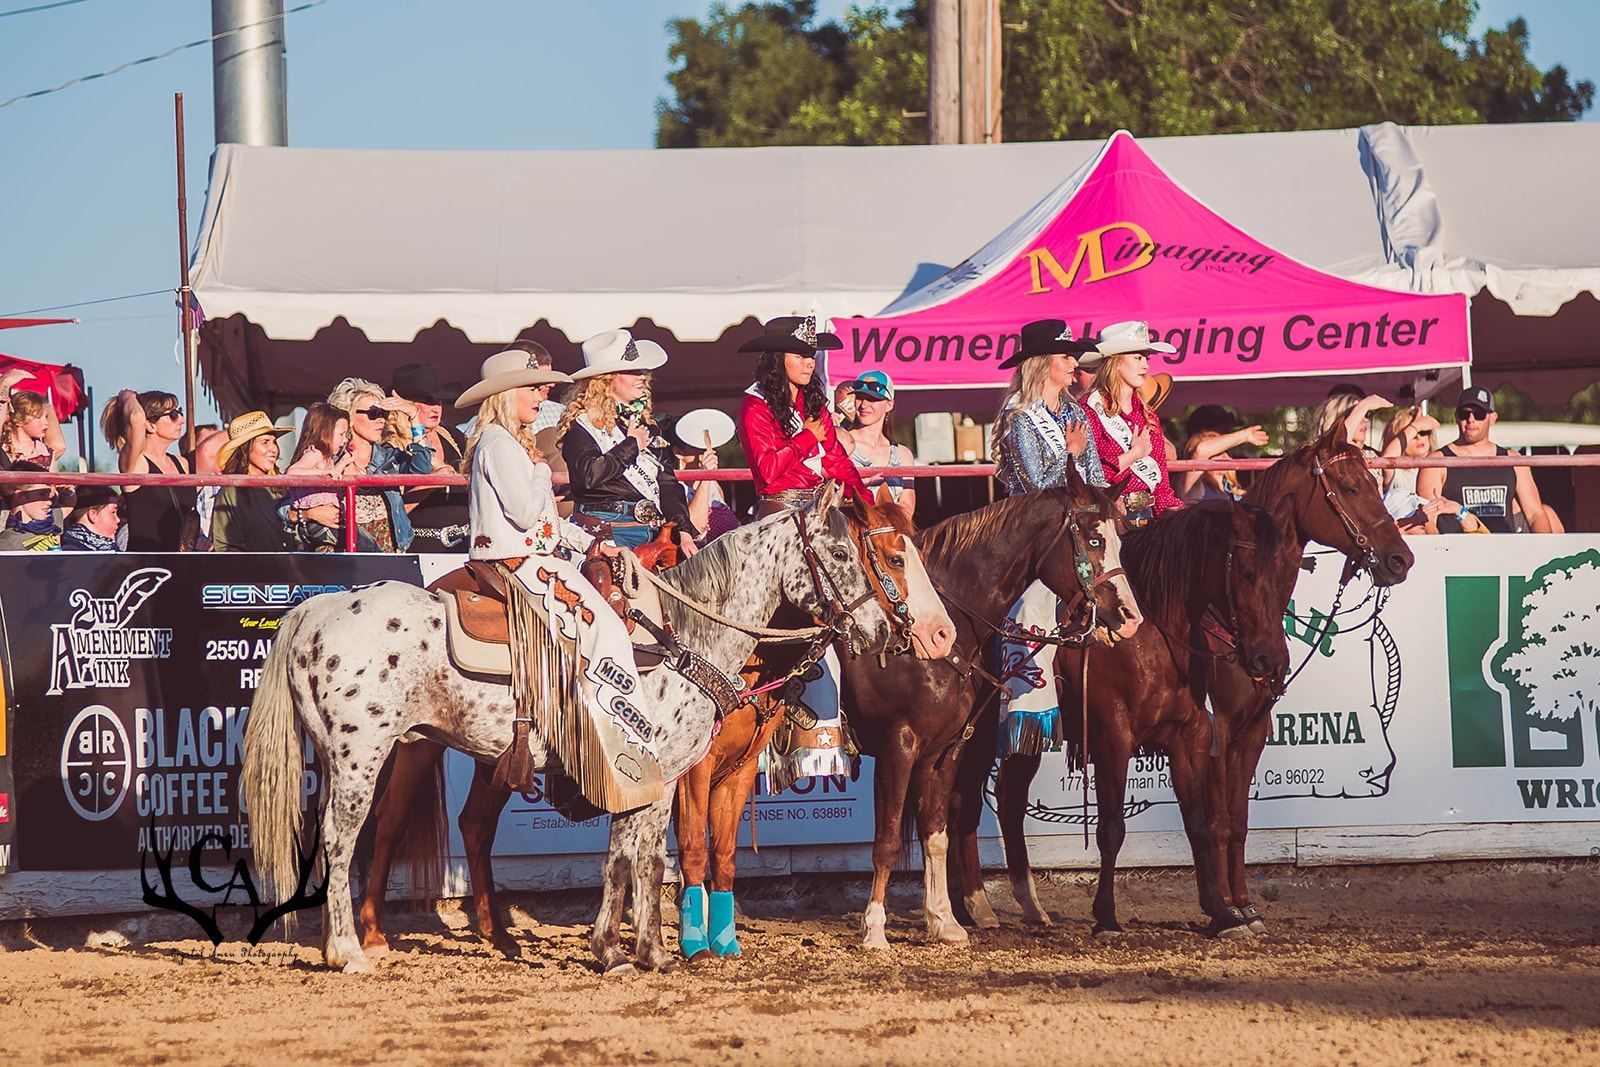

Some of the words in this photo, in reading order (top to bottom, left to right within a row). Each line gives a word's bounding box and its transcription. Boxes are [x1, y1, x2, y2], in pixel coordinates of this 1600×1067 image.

[1113, 236, 1275, 274] imaging
[851, 326, 1021, 363] Women
[1080, 318, 1265, 365] Iging
[1282, 311, 1440, 352] Center
[69, 589, 120, 631] 2ND
[46, 624, 172, 695] AMENDMENT
[206, 640, 250, 661] 2550
[95, 659, 131, 688] INK
[600, 661, 633, 690] MISS
[134, 706, 250, 769] BLACK
[135, 771, 229, 817] COFFEE
[1264, 770, 1282, 785] Ca
[1285, 769, 1325, 784] 96022
[1516, 779, 1600, 809] WRI
[740, 808, 783, 822] CENSE
[787, 809, 809, 820] NO.
[812, 807, 852, 819] 638891
